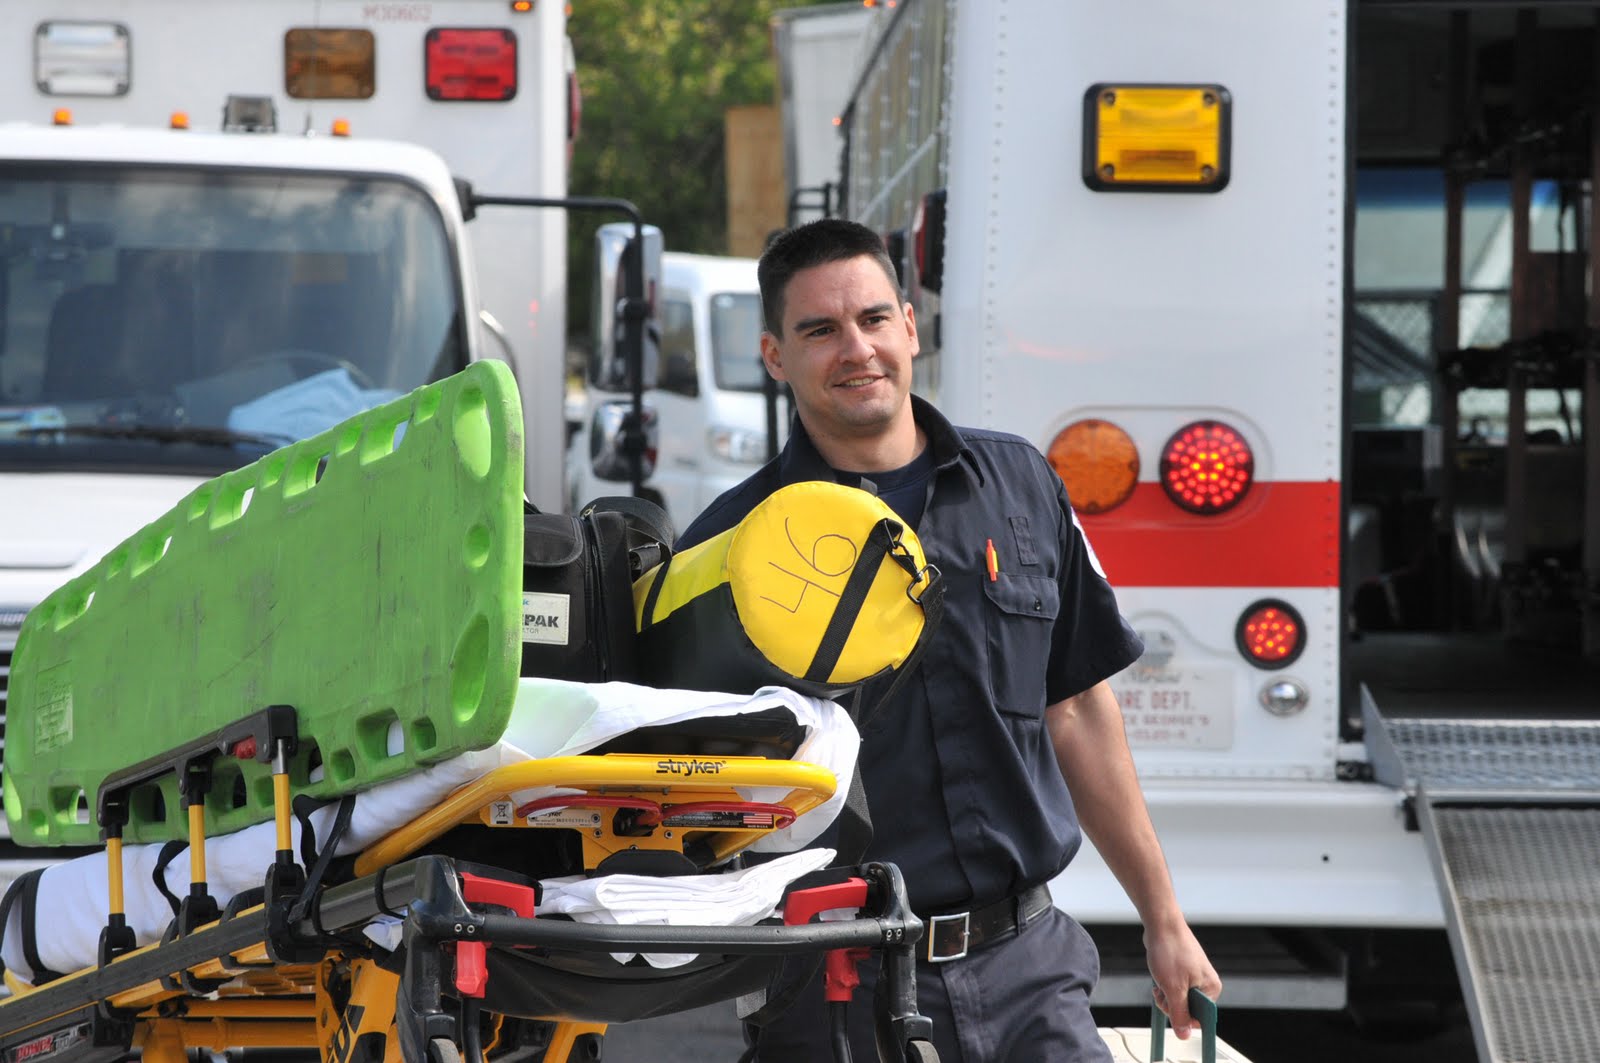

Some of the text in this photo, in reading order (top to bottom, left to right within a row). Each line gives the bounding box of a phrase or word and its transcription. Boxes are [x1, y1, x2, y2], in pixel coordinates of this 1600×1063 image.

[760, 517, 857, 613] 46
[522, 614, 559, 628] PAK
[656, 759, 724, 776] stryker
